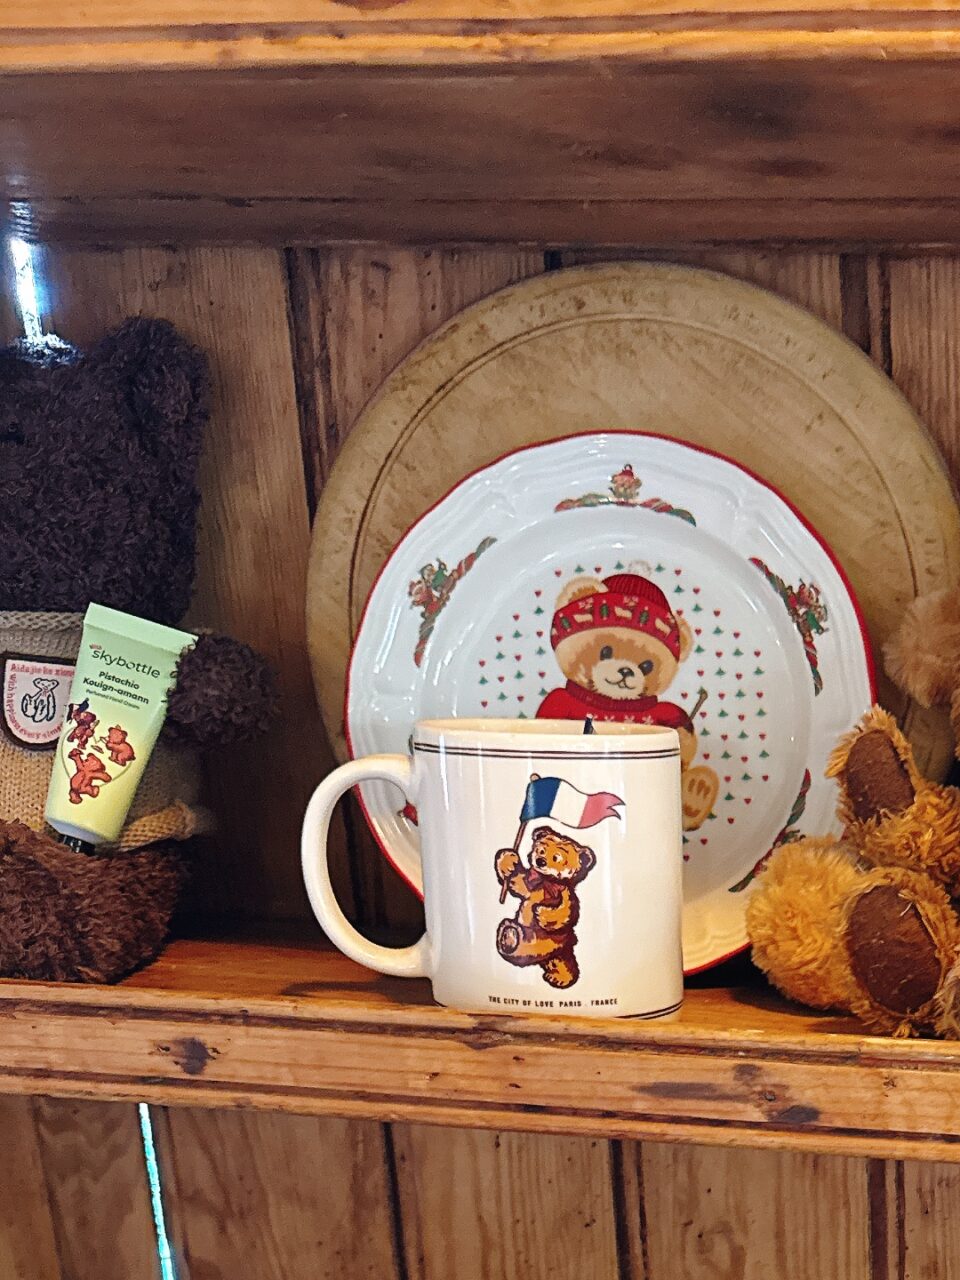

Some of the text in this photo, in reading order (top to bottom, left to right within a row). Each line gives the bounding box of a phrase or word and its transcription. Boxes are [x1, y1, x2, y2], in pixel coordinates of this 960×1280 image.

[92, 650, 160, 679] skybottle
[83, 677, 149, 704] Kouign-amann
[98, 671, 140, 690] Pistachio
[488, 996, 500, 1004] THE
[591, 998, 618, 1006] FRANCE
